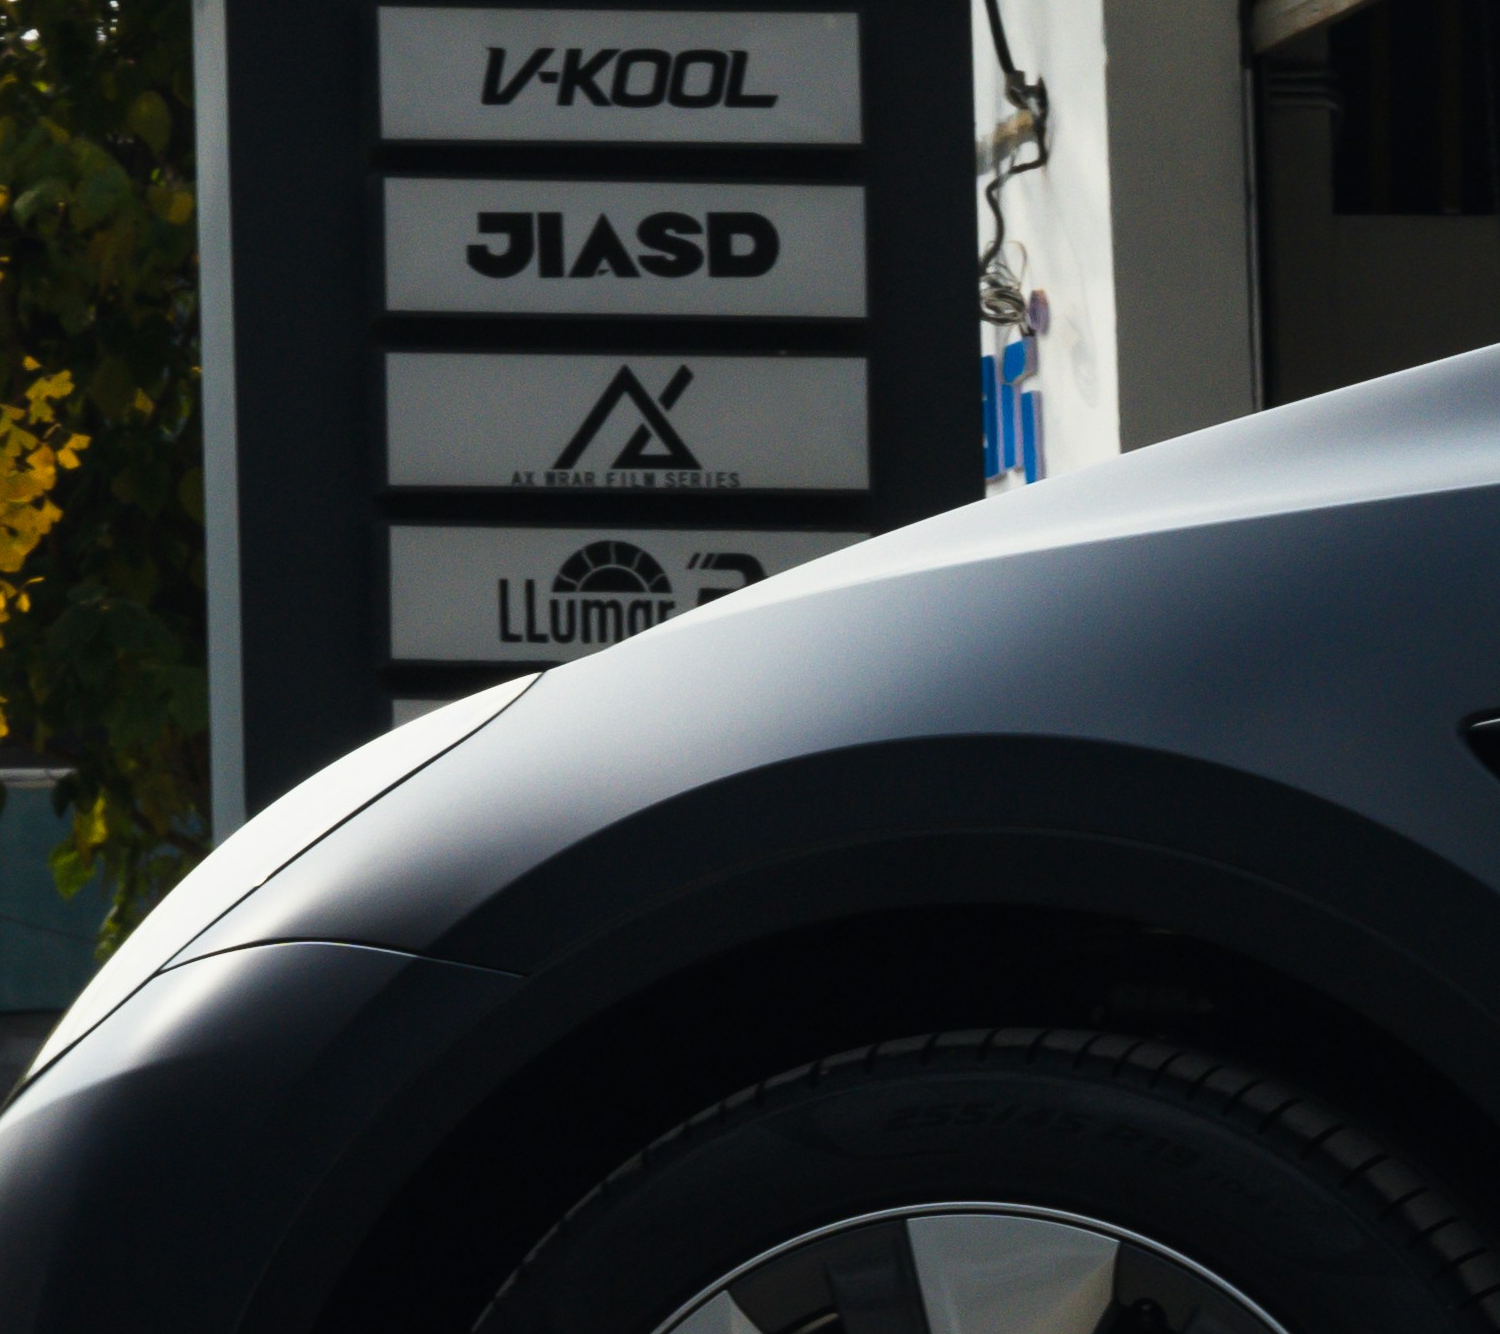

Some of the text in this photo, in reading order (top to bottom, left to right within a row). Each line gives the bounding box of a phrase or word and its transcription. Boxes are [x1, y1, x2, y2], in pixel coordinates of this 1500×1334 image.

[481, 46, 779, 109] V-KOOL
[466, 211, 780, 279] JIASD
[511, 471, 535, 487] AX
[606, 471, 656, 488] FILM
[665, 471, 742, 488] SERIES
